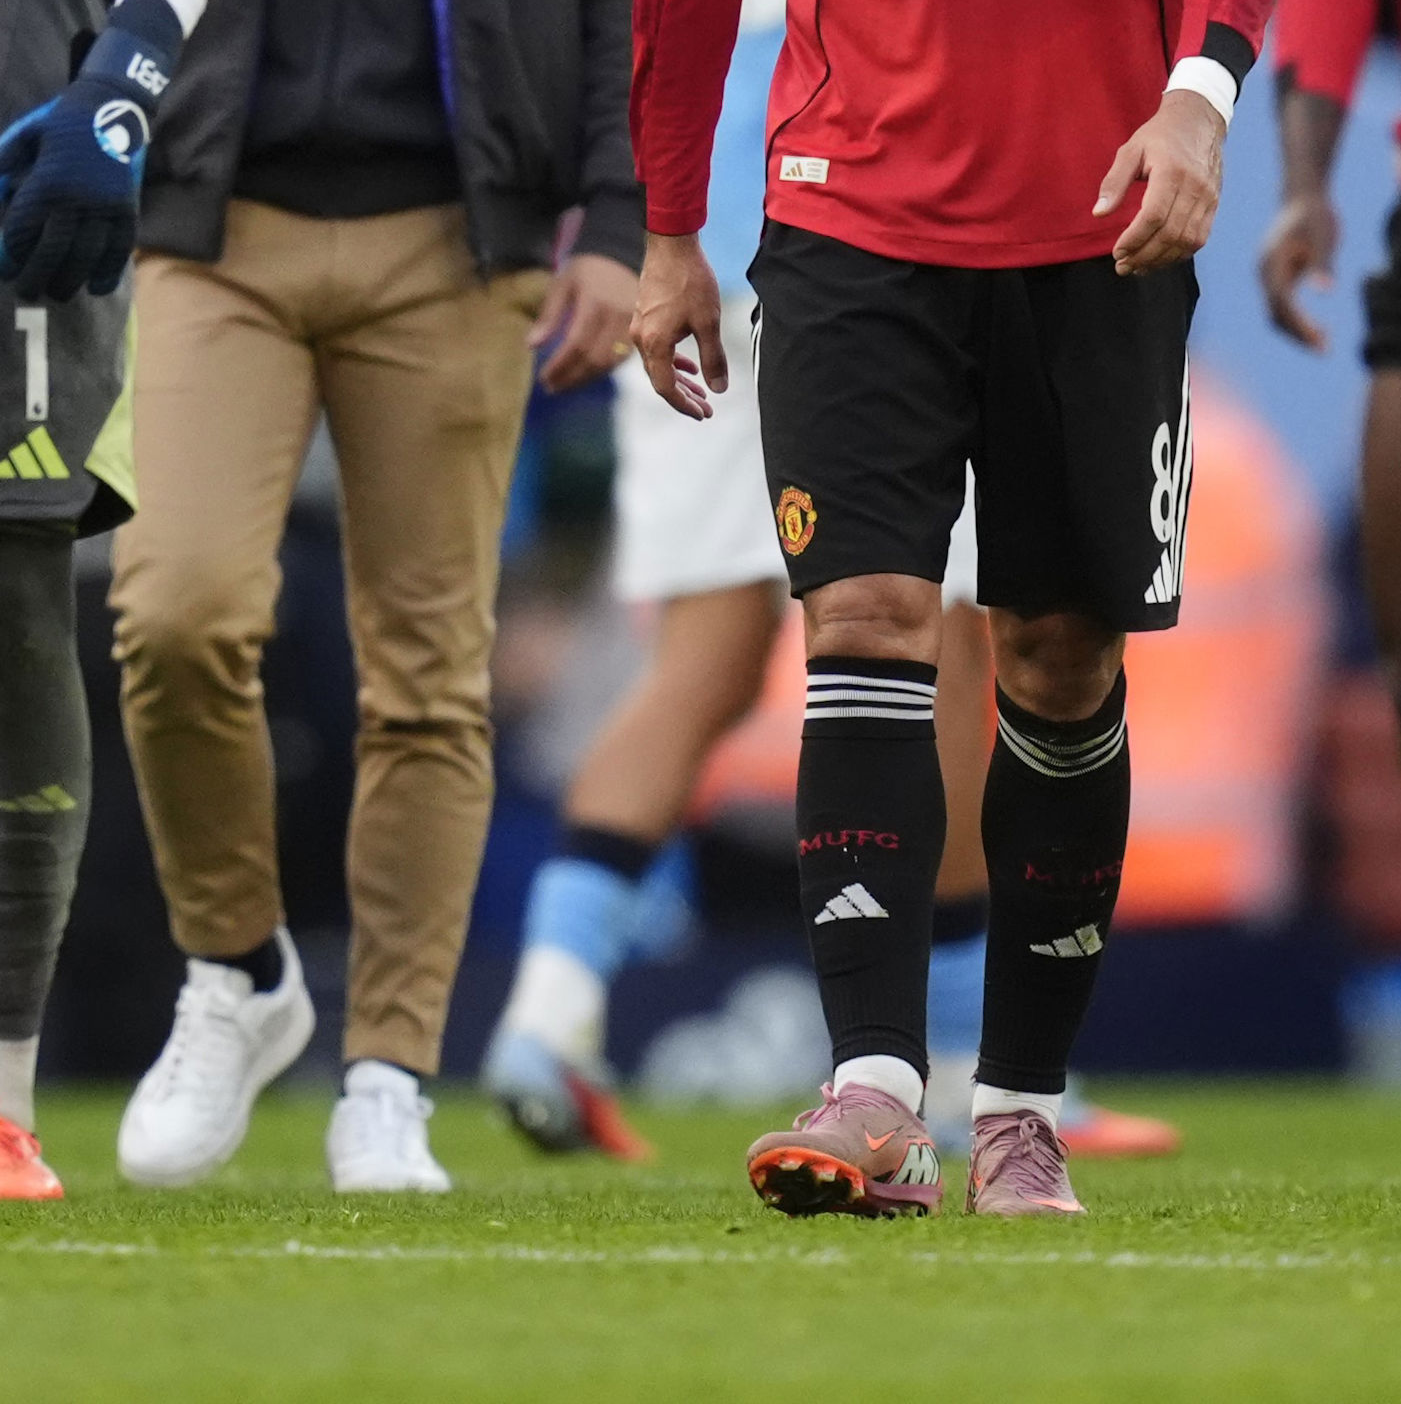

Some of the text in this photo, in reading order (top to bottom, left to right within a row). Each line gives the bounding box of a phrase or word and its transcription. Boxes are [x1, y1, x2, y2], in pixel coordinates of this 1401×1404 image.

[15, 307, 49, 422] 1
[1150, 421, 1173, 544] 8
[799, 830, 899, 855] MUFC
